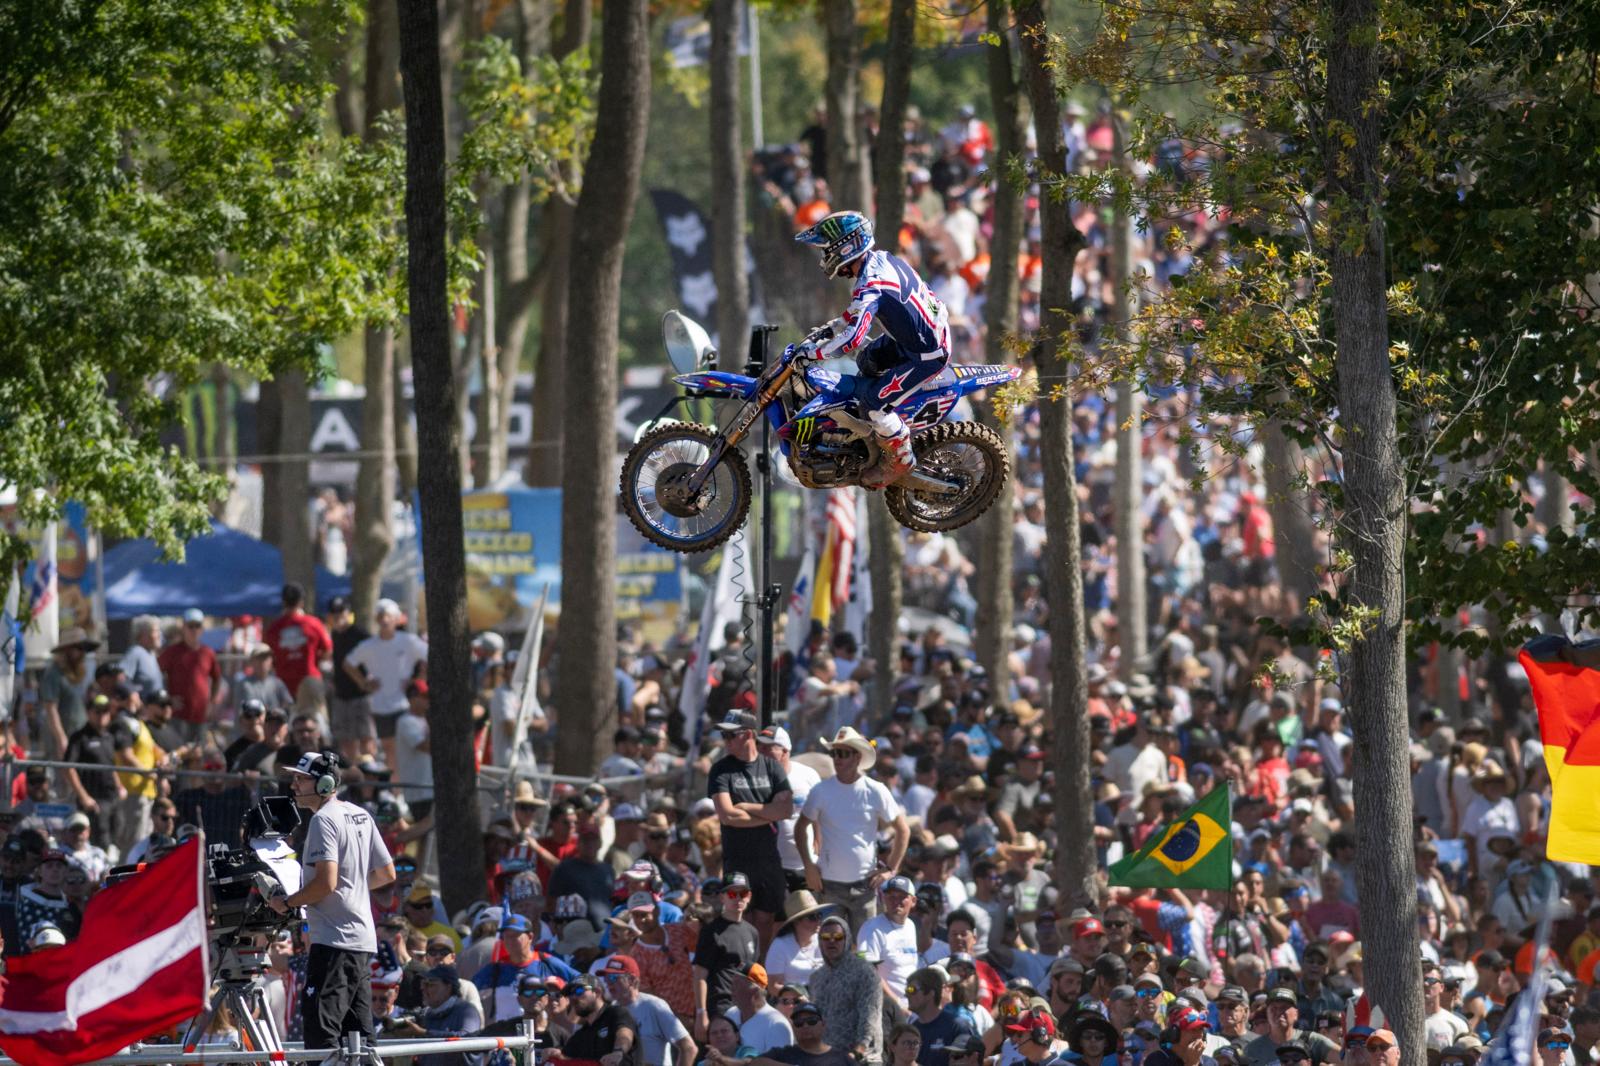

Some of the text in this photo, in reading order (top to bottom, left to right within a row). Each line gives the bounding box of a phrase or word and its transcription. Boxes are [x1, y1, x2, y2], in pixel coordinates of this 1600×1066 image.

[828, 231, 858, 253] OAKLEY
[976, 373, 1009, 384] DUNLOP
[913, 400, 942, 425] 4
